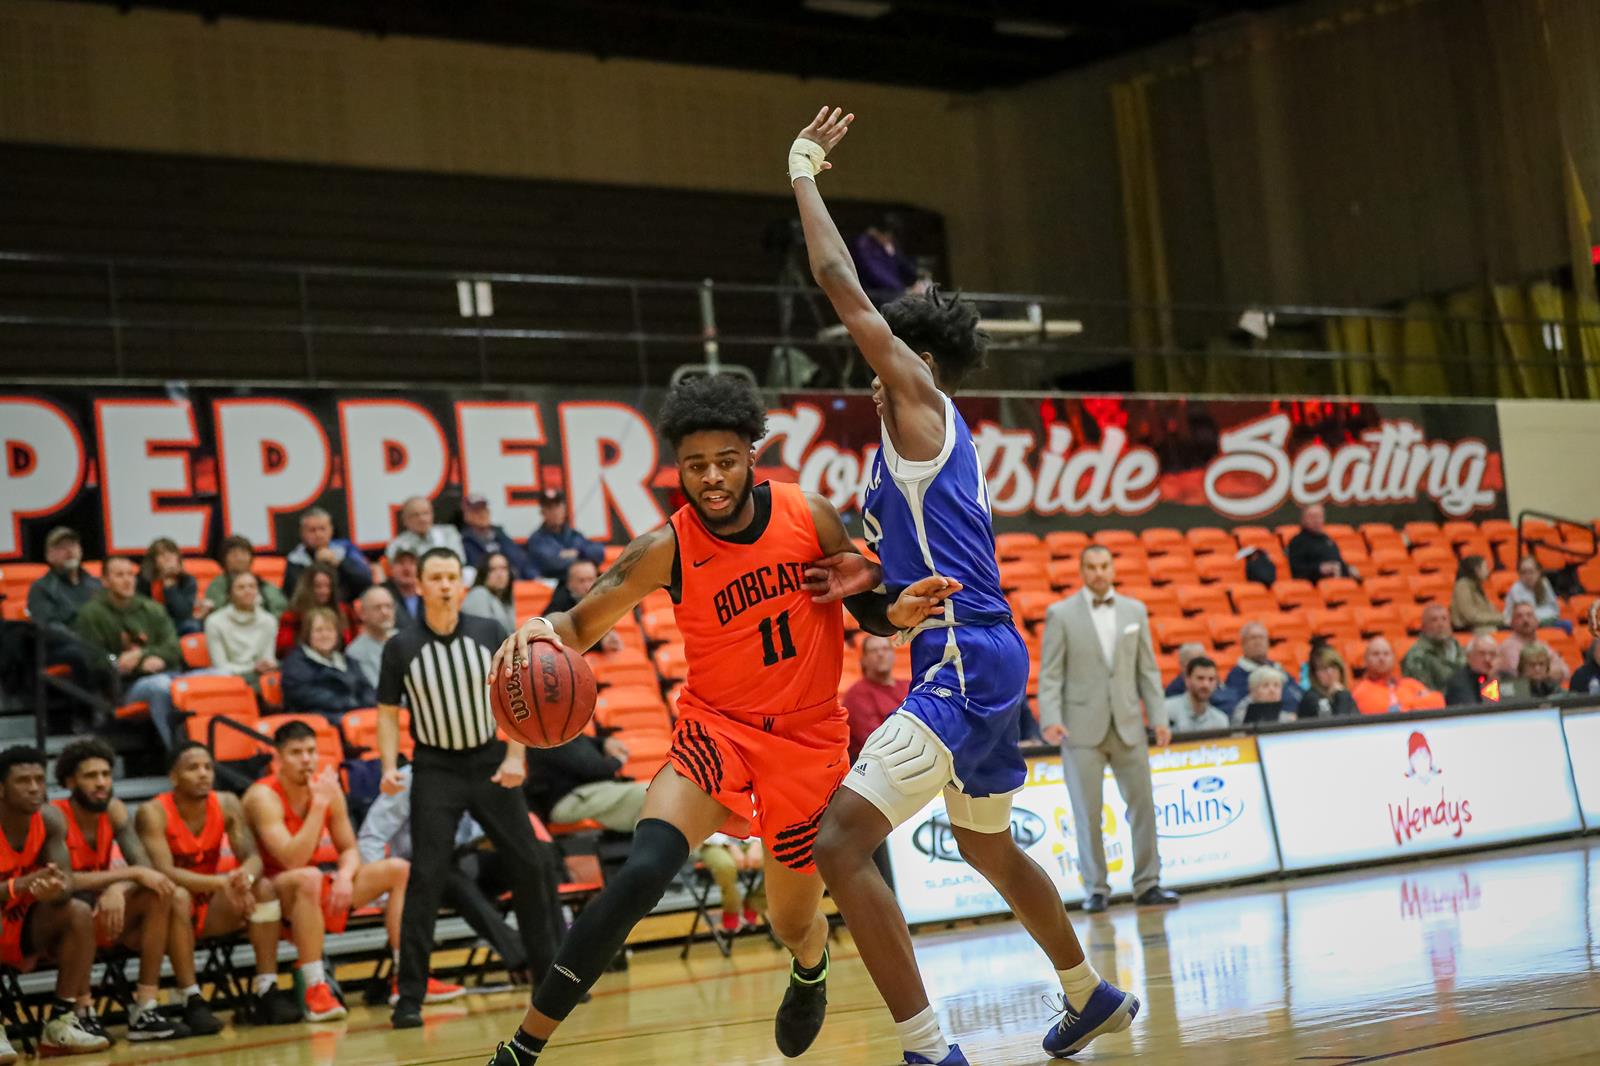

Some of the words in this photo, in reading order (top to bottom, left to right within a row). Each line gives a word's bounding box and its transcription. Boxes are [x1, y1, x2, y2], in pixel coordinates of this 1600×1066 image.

[0, 397, 669, 558] PEPPER
[1204, 411, 1497, 519] Seating
[758, 609, 797, 667] 11
[540, 653, 561, 704] NCAA
[1155, 788, 1233, 826] enkins
